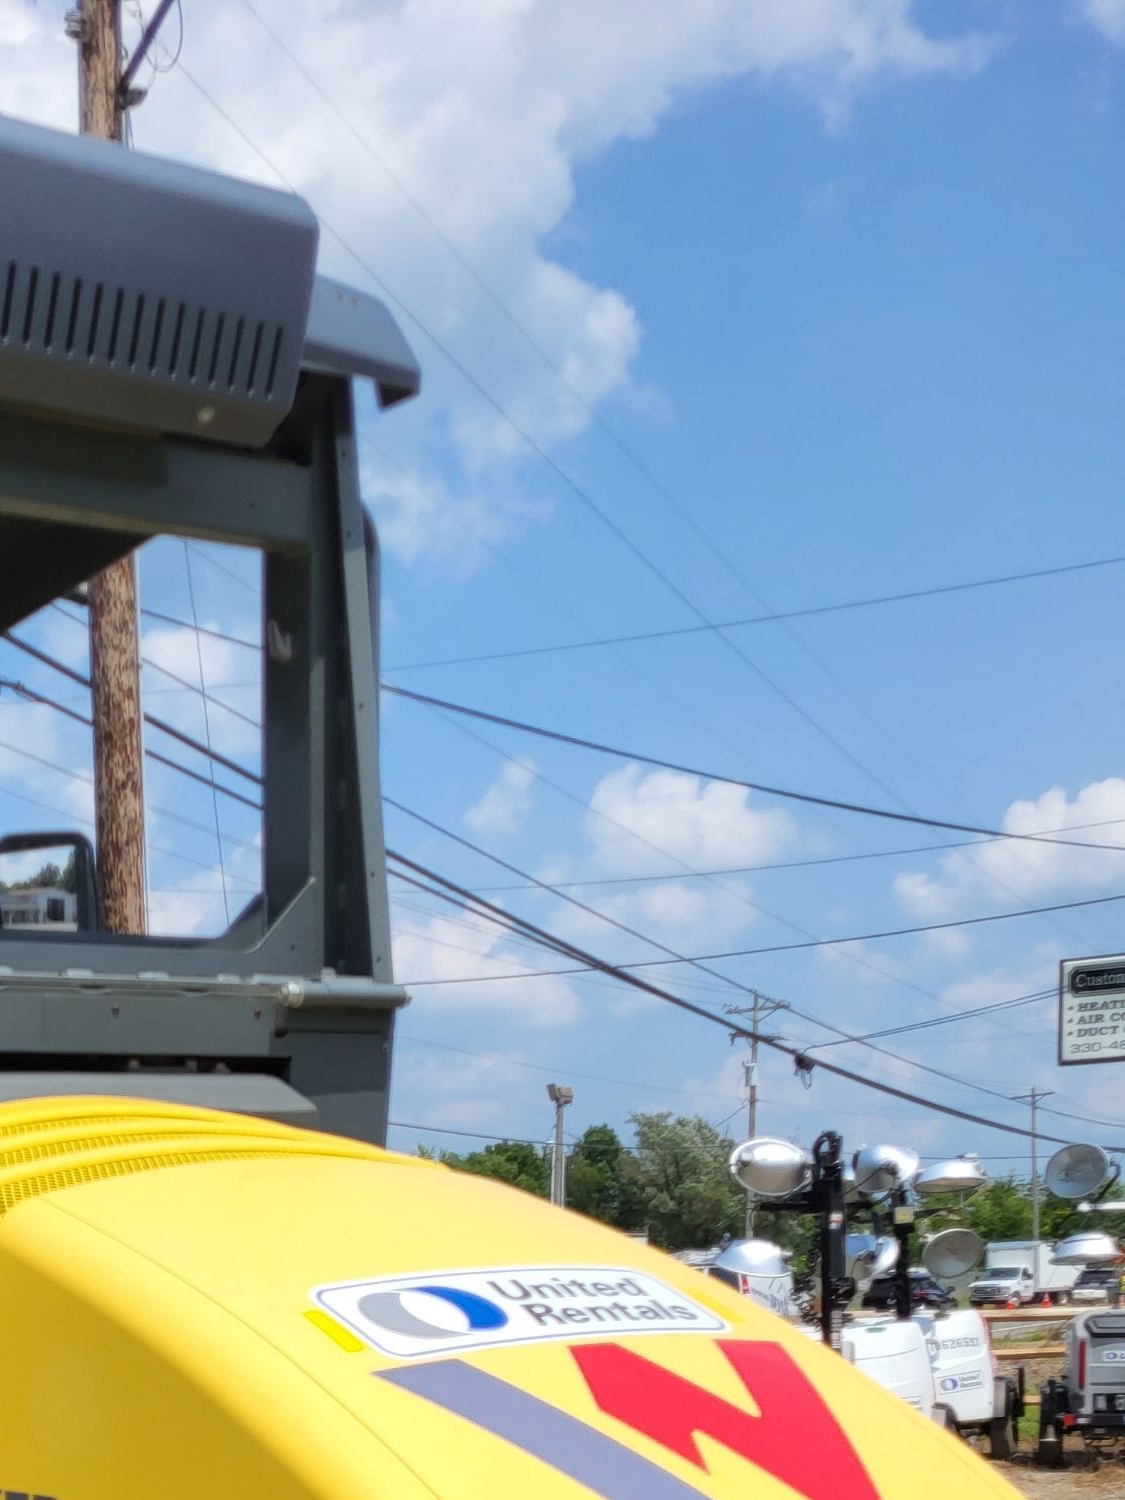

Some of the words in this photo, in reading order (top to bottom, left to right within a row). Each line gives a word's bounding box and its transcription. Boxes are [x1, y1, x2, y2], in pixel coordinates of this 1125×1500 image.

[1076, 1014, 1105, 1025] AIR
[1076, 1025, 1119, 1038] DUCT
[486, 1277, 649, 1302] United
[521, 1301, 699, 1327] Rentals
